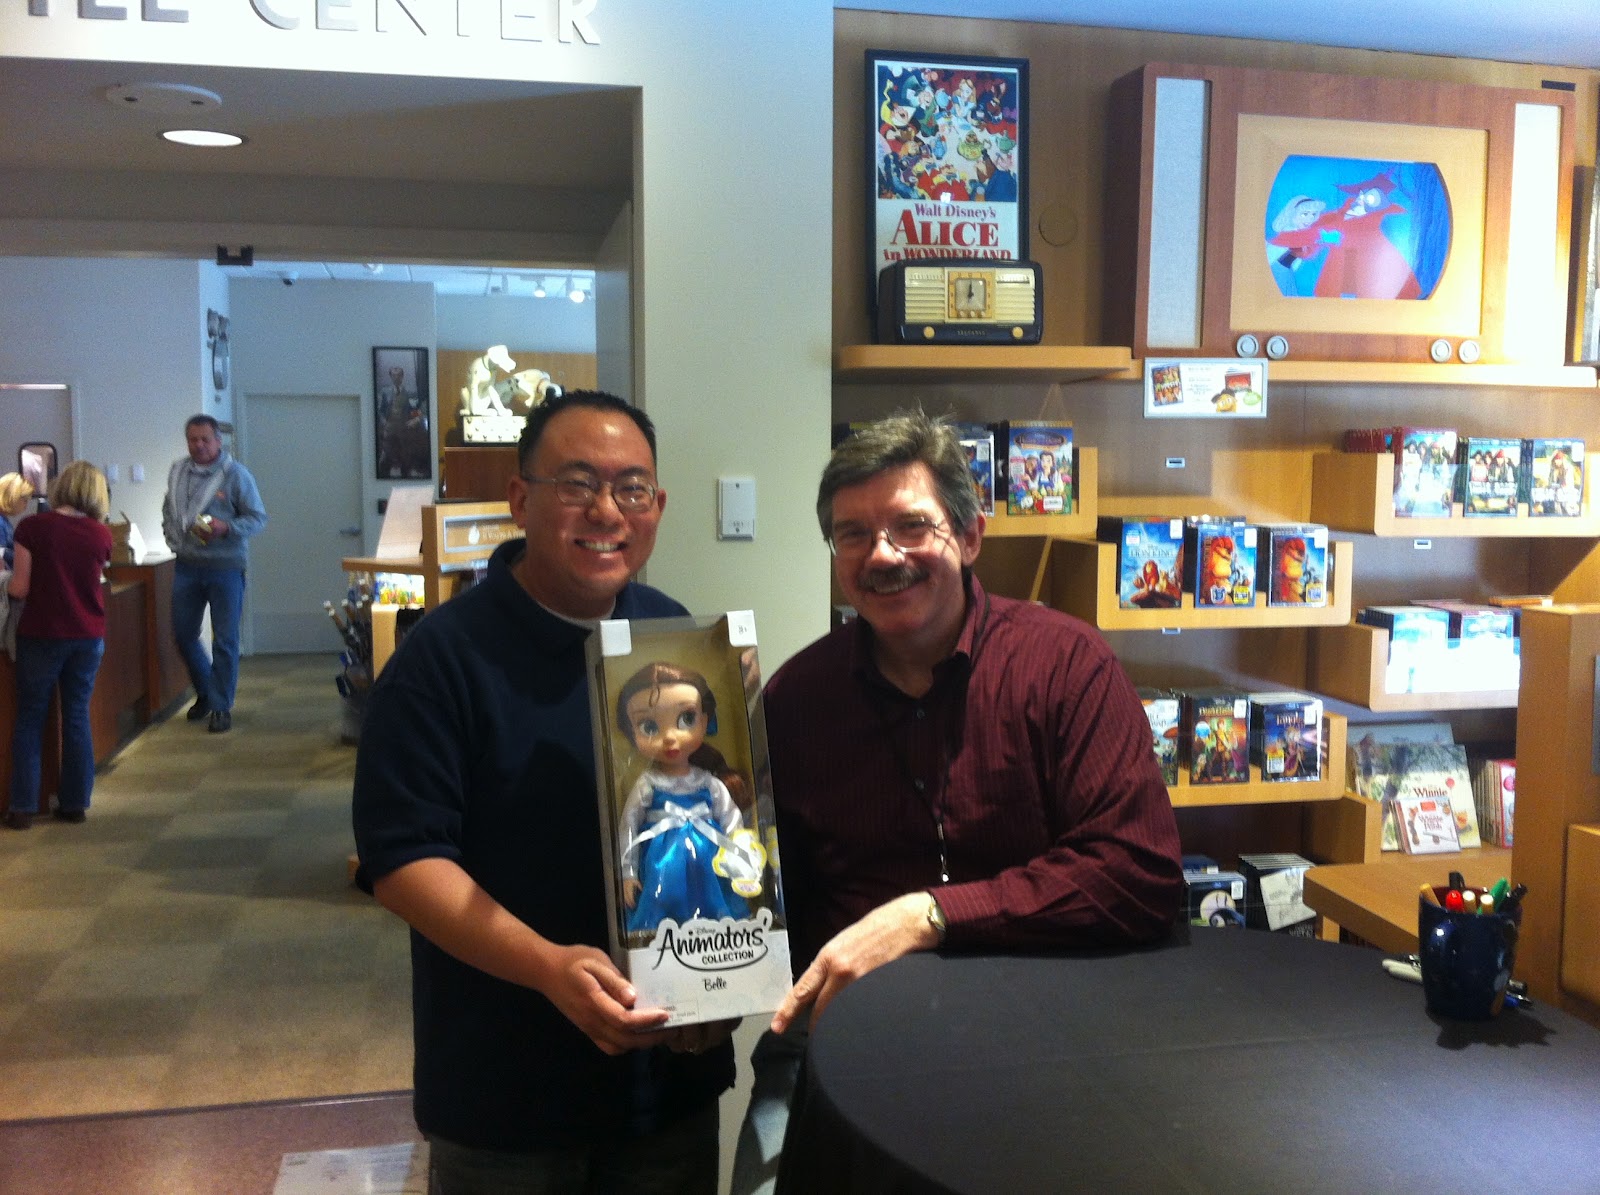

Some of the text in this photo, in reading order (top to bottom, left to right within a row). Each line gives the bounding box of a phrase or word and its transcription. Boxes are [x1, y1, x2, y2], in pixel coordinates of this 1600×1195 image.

[915, 203, 997, 221] Walt Disney's
[890, 209, 999, 247] ALICE
[884, 248, 1011, 261] in WONDERLAND
[1412, 786, 1448, 798] Winnie
[701, 950, 754, 965] COLLECTION
[703, 977, 727, 991] Belle
